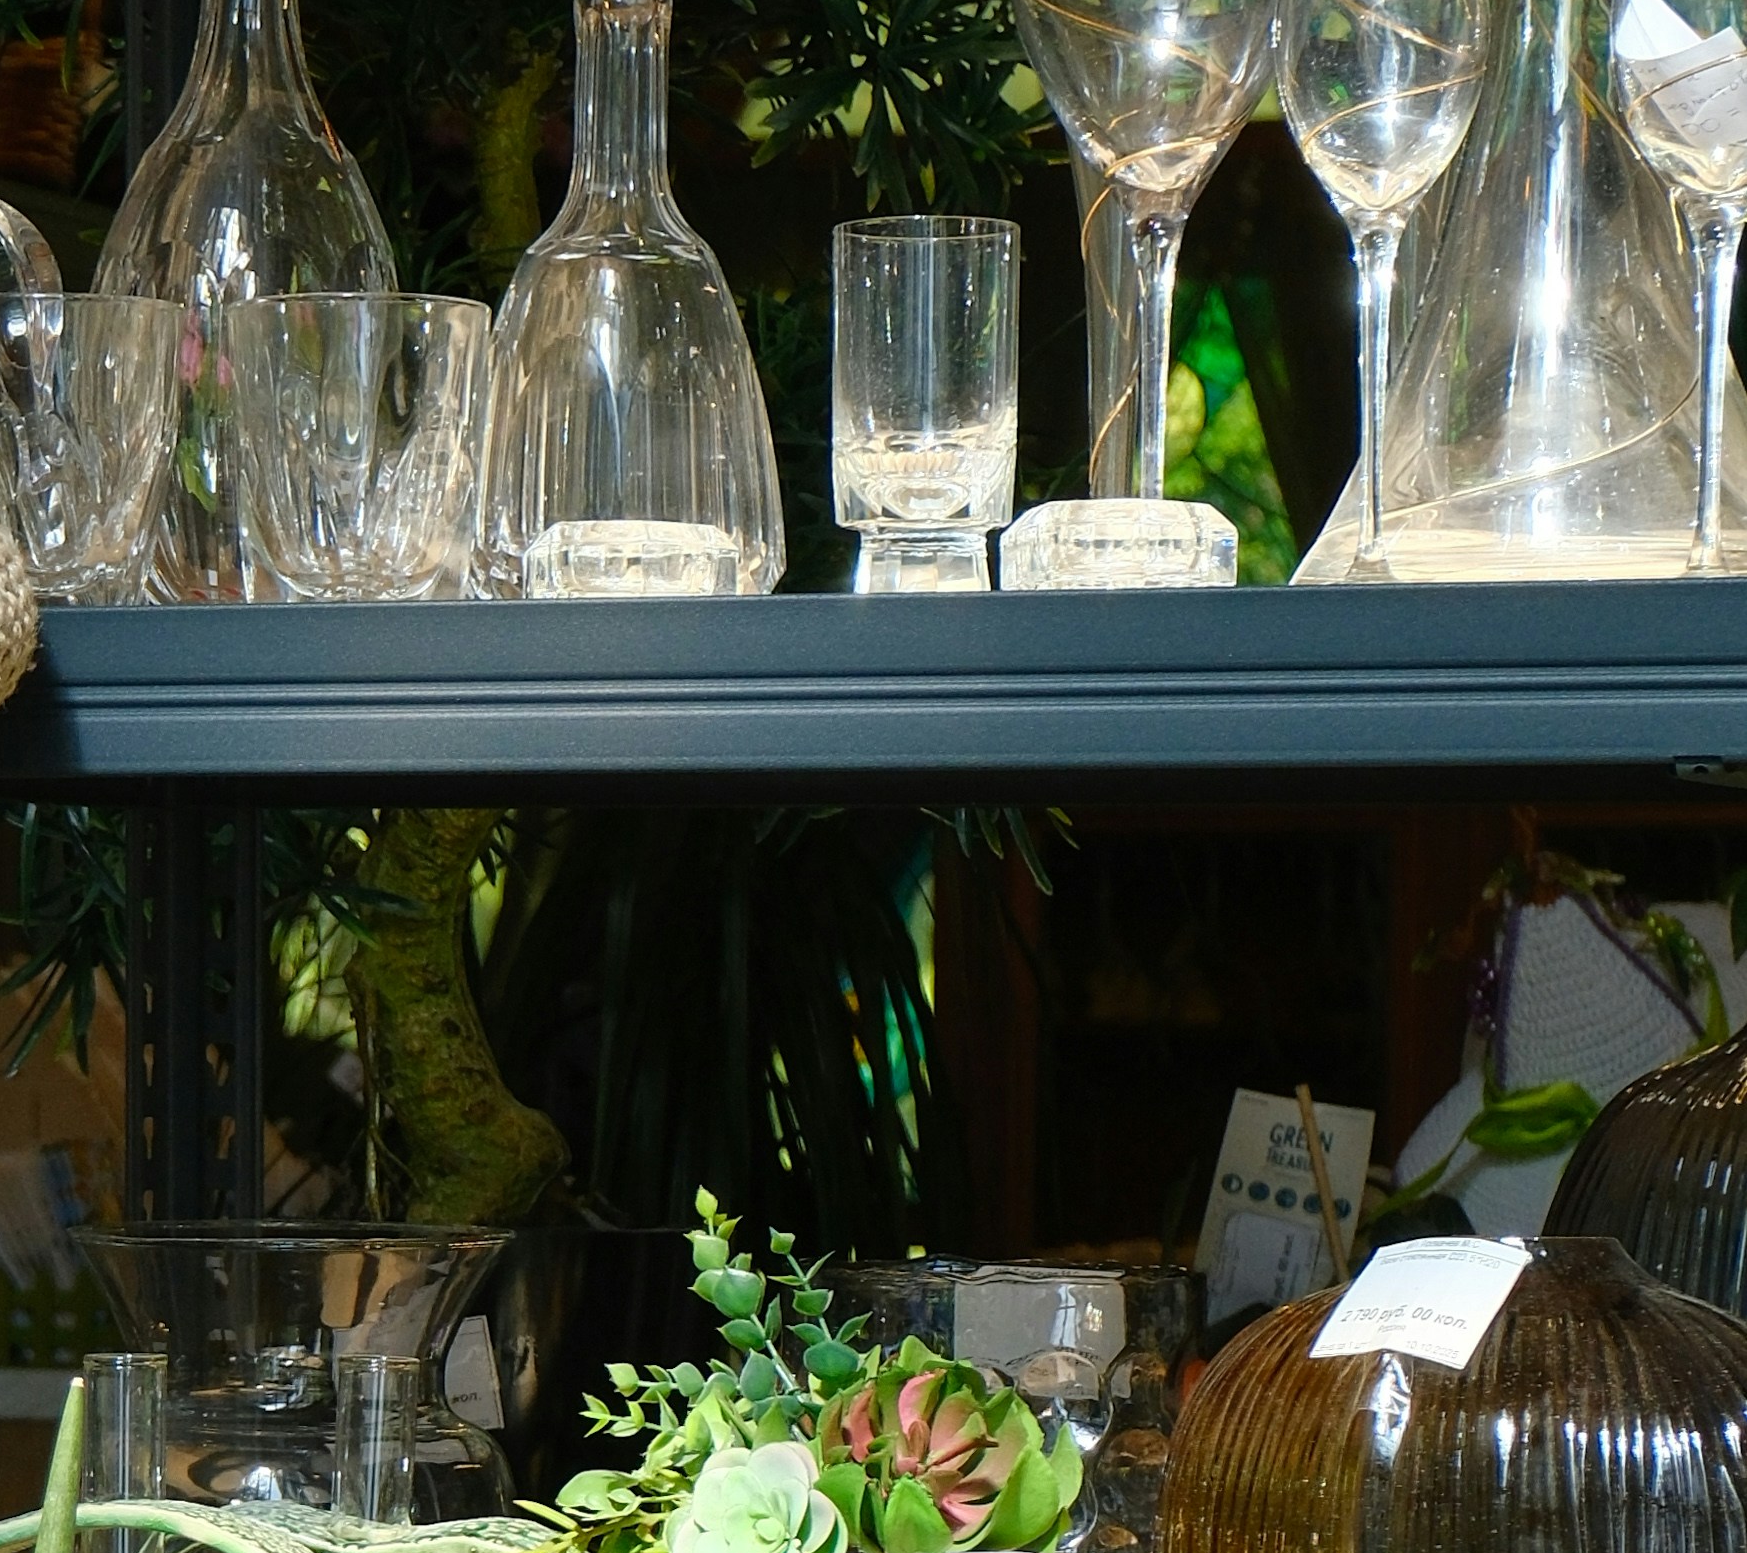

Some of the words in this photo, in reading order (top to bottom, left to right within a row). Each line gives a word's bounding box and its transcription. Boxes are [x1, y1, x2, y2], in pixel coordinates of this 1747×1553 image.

[1270, 1122, 1334, 1153] GREN
[1410, 1306, 1434, 1321] 00
[1434, 1313, 1468, 1330] коп.
